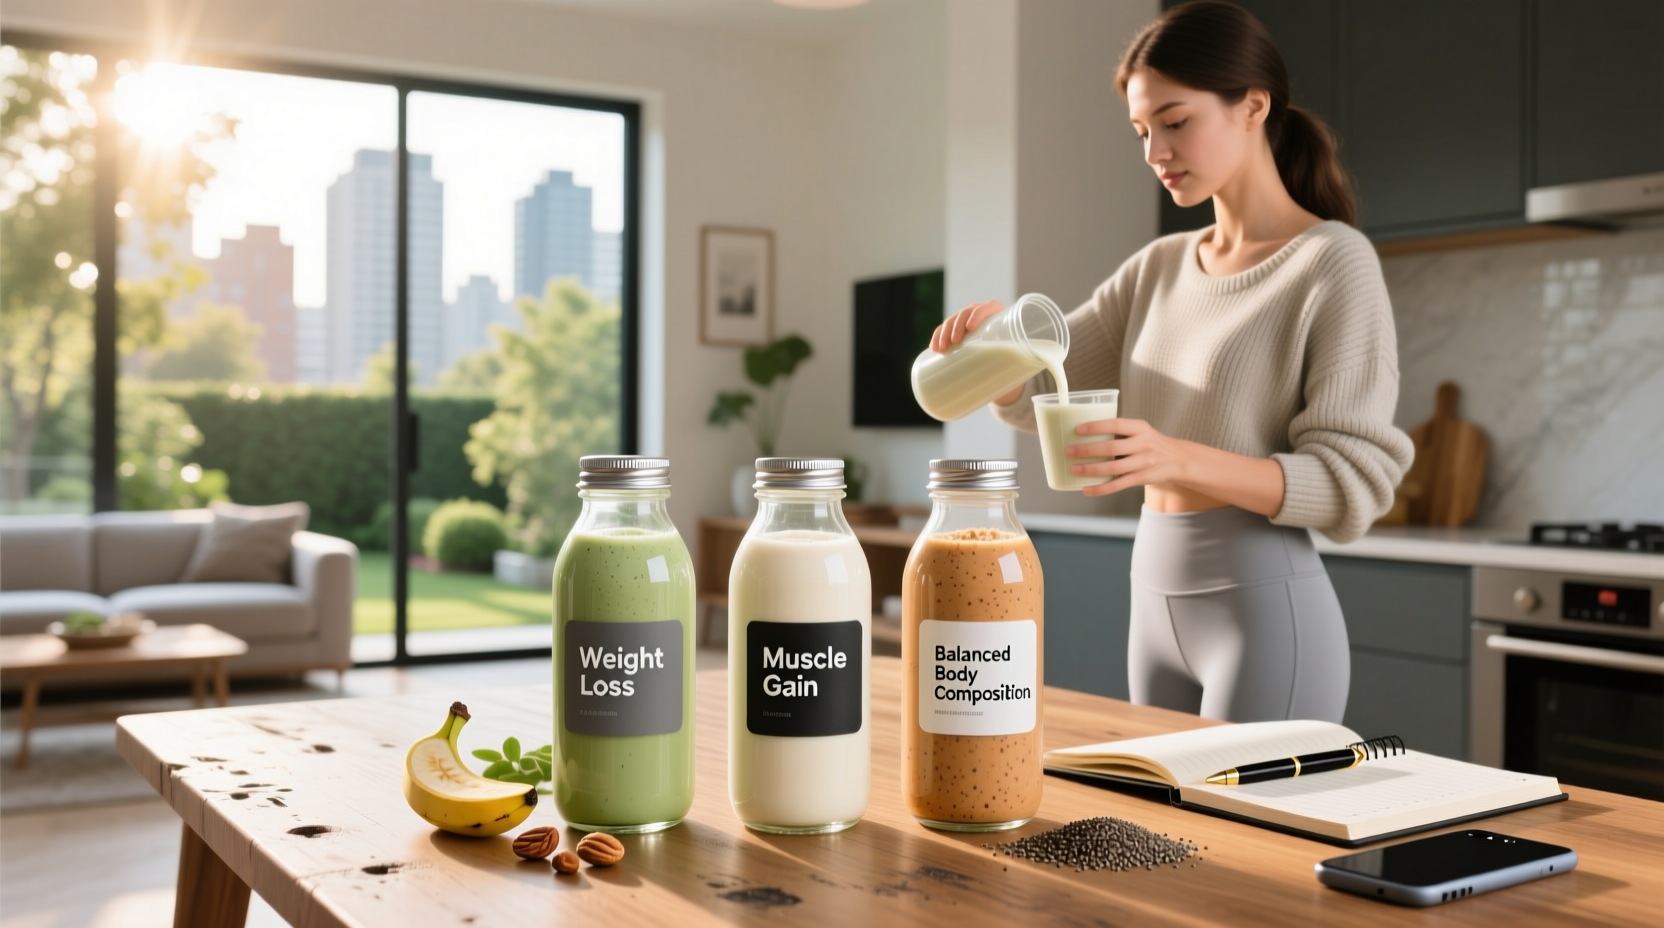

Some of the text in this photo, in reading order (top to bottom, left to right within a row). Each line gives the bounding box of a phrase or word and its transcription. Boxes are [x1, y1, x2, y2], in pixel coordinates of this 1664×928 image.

[579, 645, 665, 675] Weight
[763, 645, 847, 670] Muscle
[935, 645, 1011, 662] Balanced
[580, 675, 635, 697] Loss
[763, 674, 818, 698] Gain
[935, 665, 979, 686] Body
[934, 683, 1031, 706] Composition
